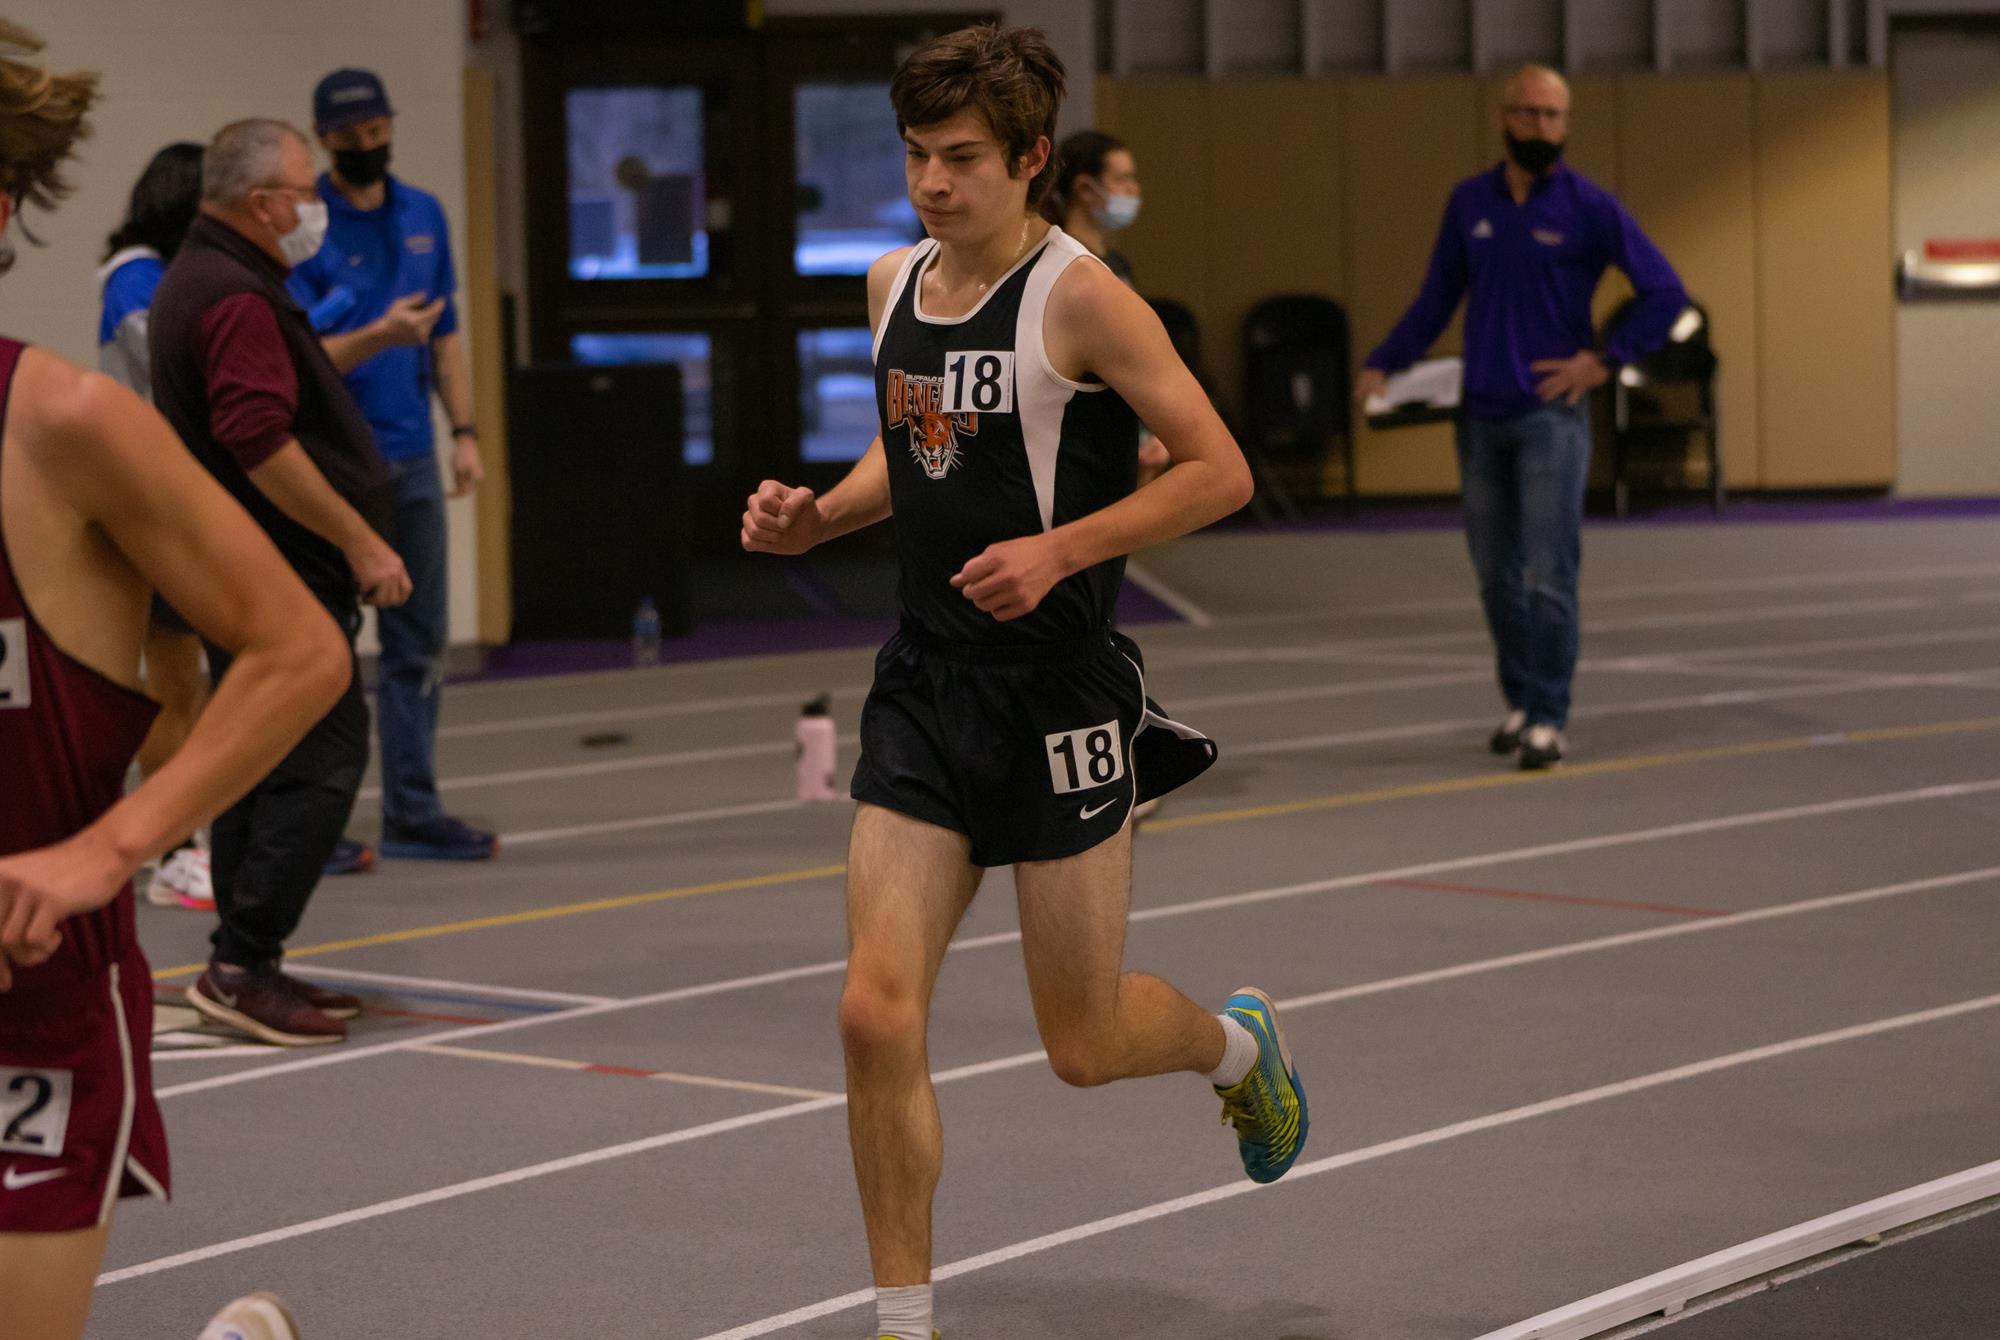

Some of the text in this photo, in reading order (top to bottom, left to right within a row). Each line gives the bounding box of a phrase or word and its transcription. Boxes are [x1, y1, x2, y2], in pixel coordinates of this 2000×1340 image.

[887, 369, 978, 436] BENG
[949, 355, 1001, 410] 18
[1052, 729, 1115, 790] 18
[3, 1075, 53, 1144] 2
